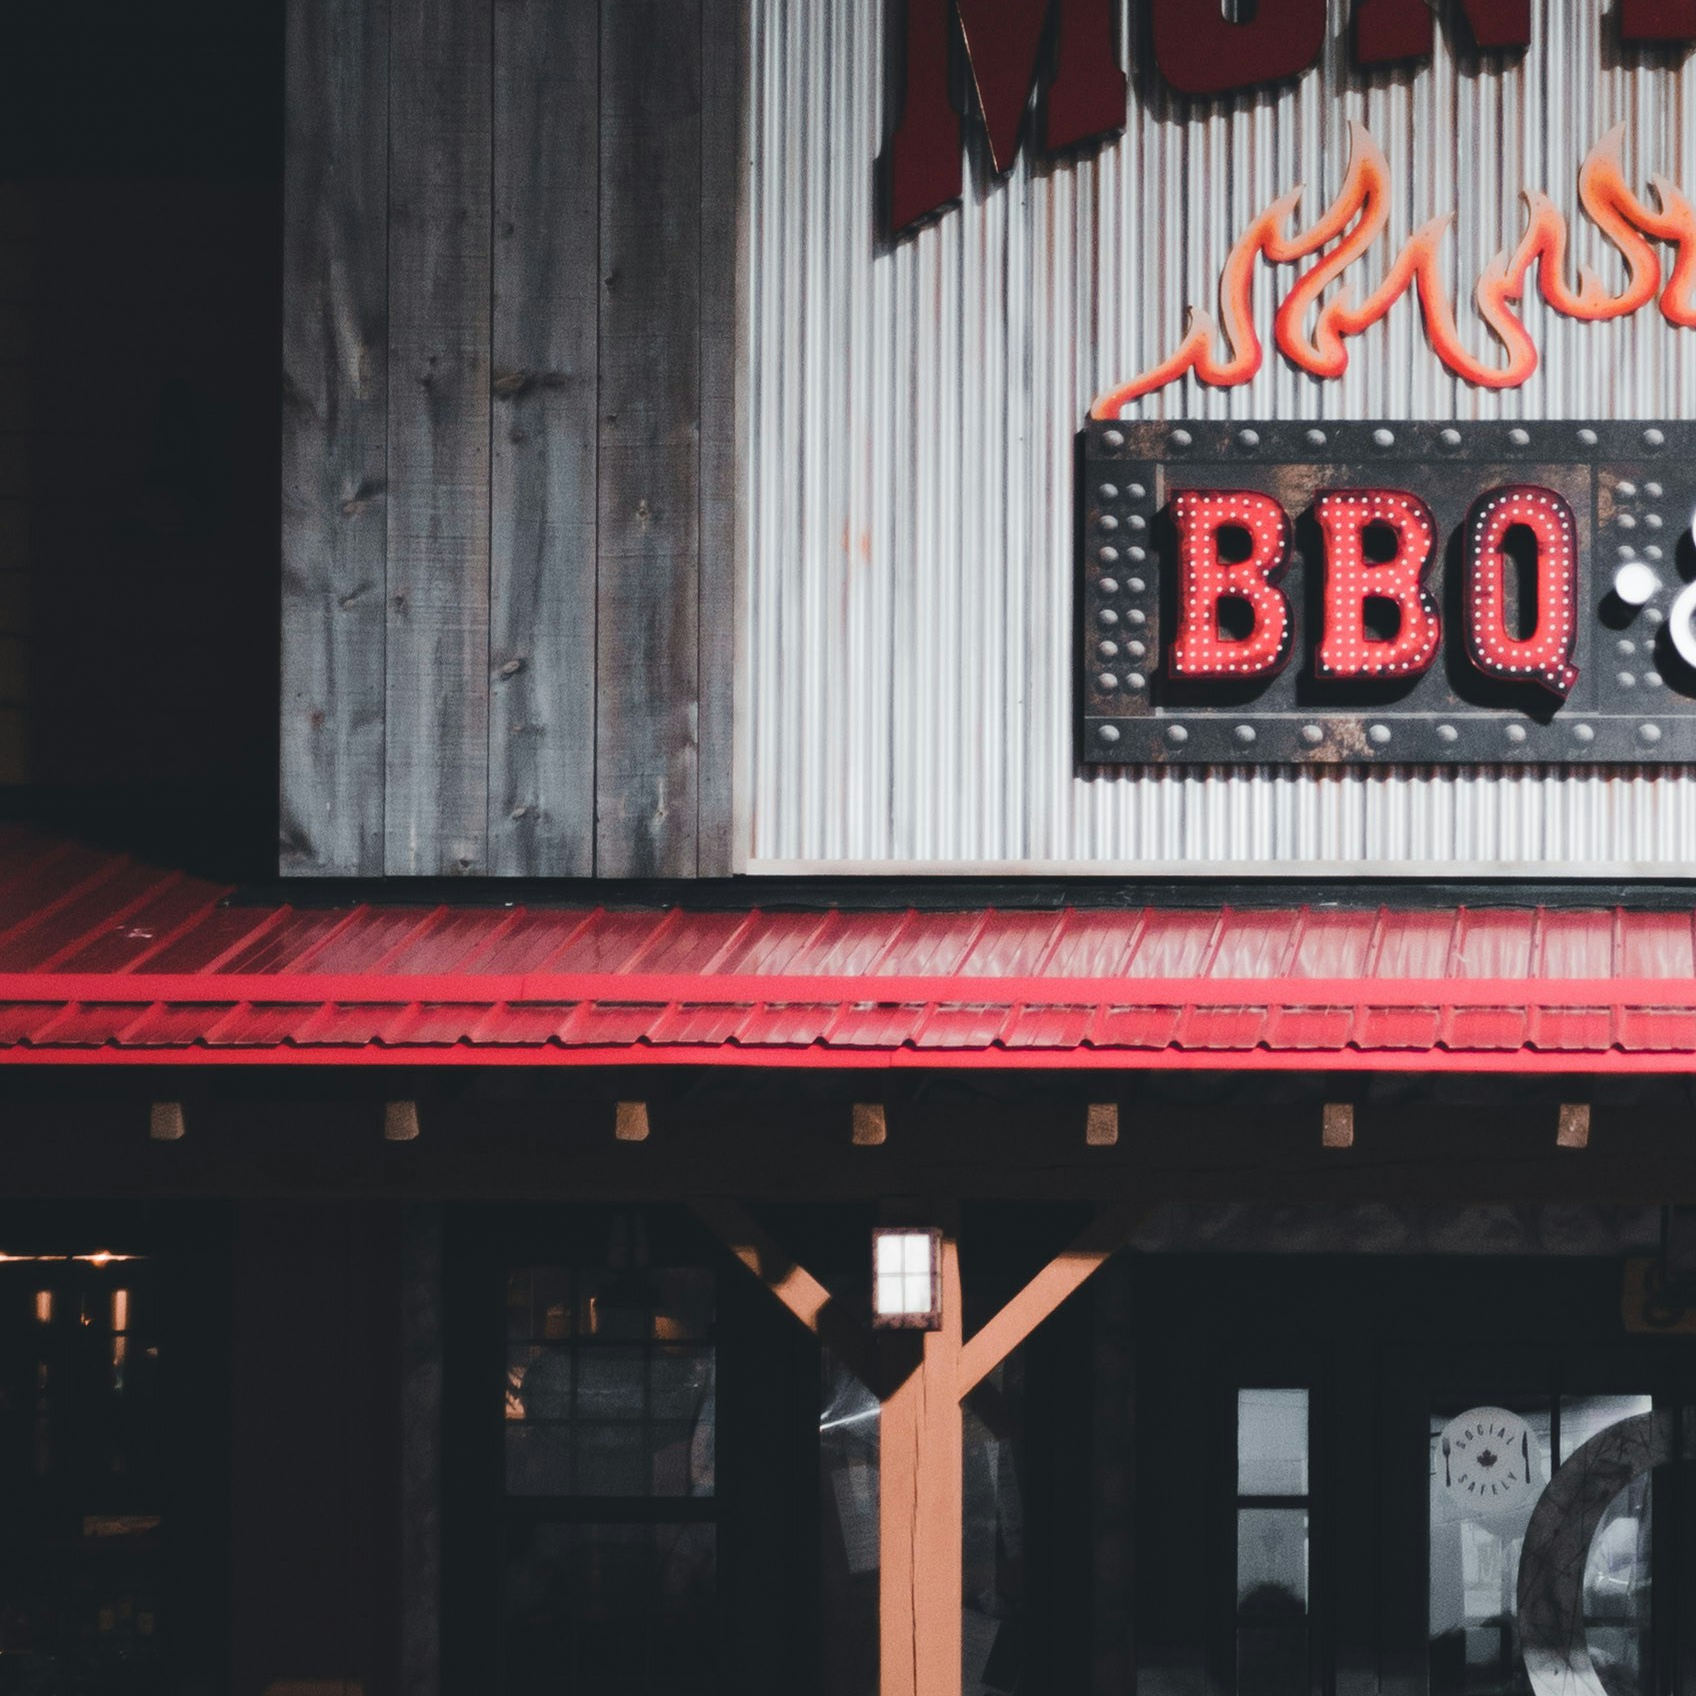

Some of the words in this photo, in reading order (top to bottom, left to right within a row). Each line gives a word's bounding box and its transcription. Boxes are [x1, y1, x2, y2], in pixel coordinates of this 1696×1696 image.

[1168, 483, 1581, 698] BBQ
[1456, 1424, 1515, 1450] SOCIAL
[1458, 1471, 1517, 1496] SAFELY
